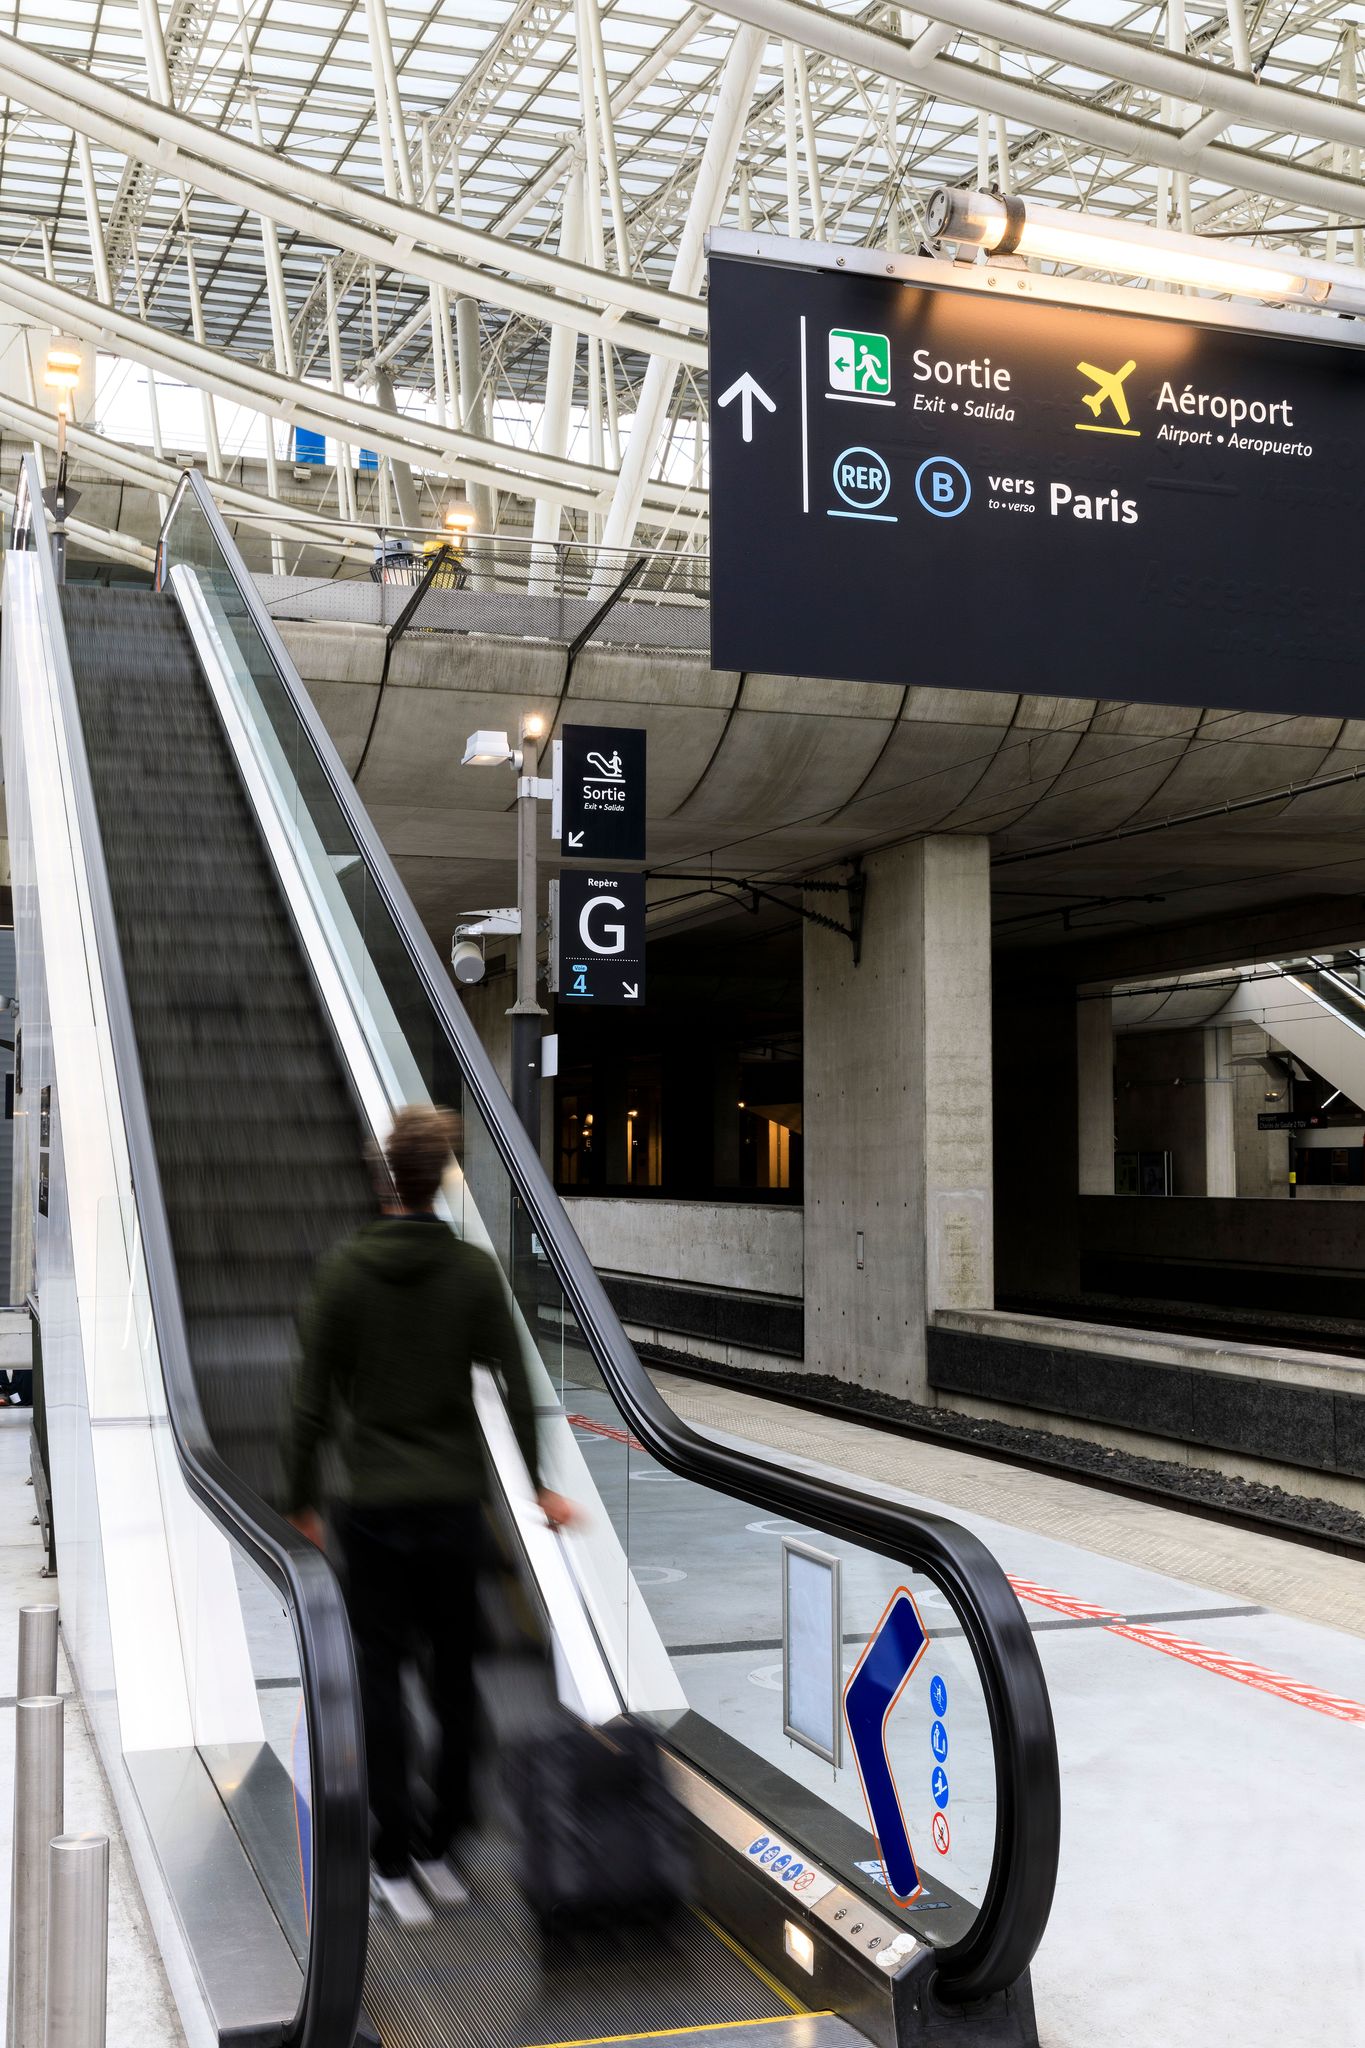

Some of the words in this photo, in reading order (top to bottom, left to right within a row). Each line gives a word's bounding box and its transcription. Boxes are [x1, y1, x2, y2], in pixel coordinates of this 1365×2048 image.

[913, 350, 1011, 391] Sortie
[913, 394, 946, 413] Exit
[963, 400, 1015, 422] Salida
[1156, 381, 1294, 428] Aéroport
[1157, 424, 1212, 445] Airport
[1228, 433, 1313, 457] Aeropuerto
[841, 465, 883, 491] RER
[932, 471, 954, 502] B
[988, 475, 1036, 495] vers
[1008, 502, 1036, 513] verso
[1050, 482, 1139, 524] Paris
[583, 785, 626, 801] Sortie
[584, 802, 598, 810] Exit
[603, 803, 625, 812] Salida
[588, 878, 618, 888] Repère
[579, 895, 625, 955] G
[573, 974, 587, 993] 4
